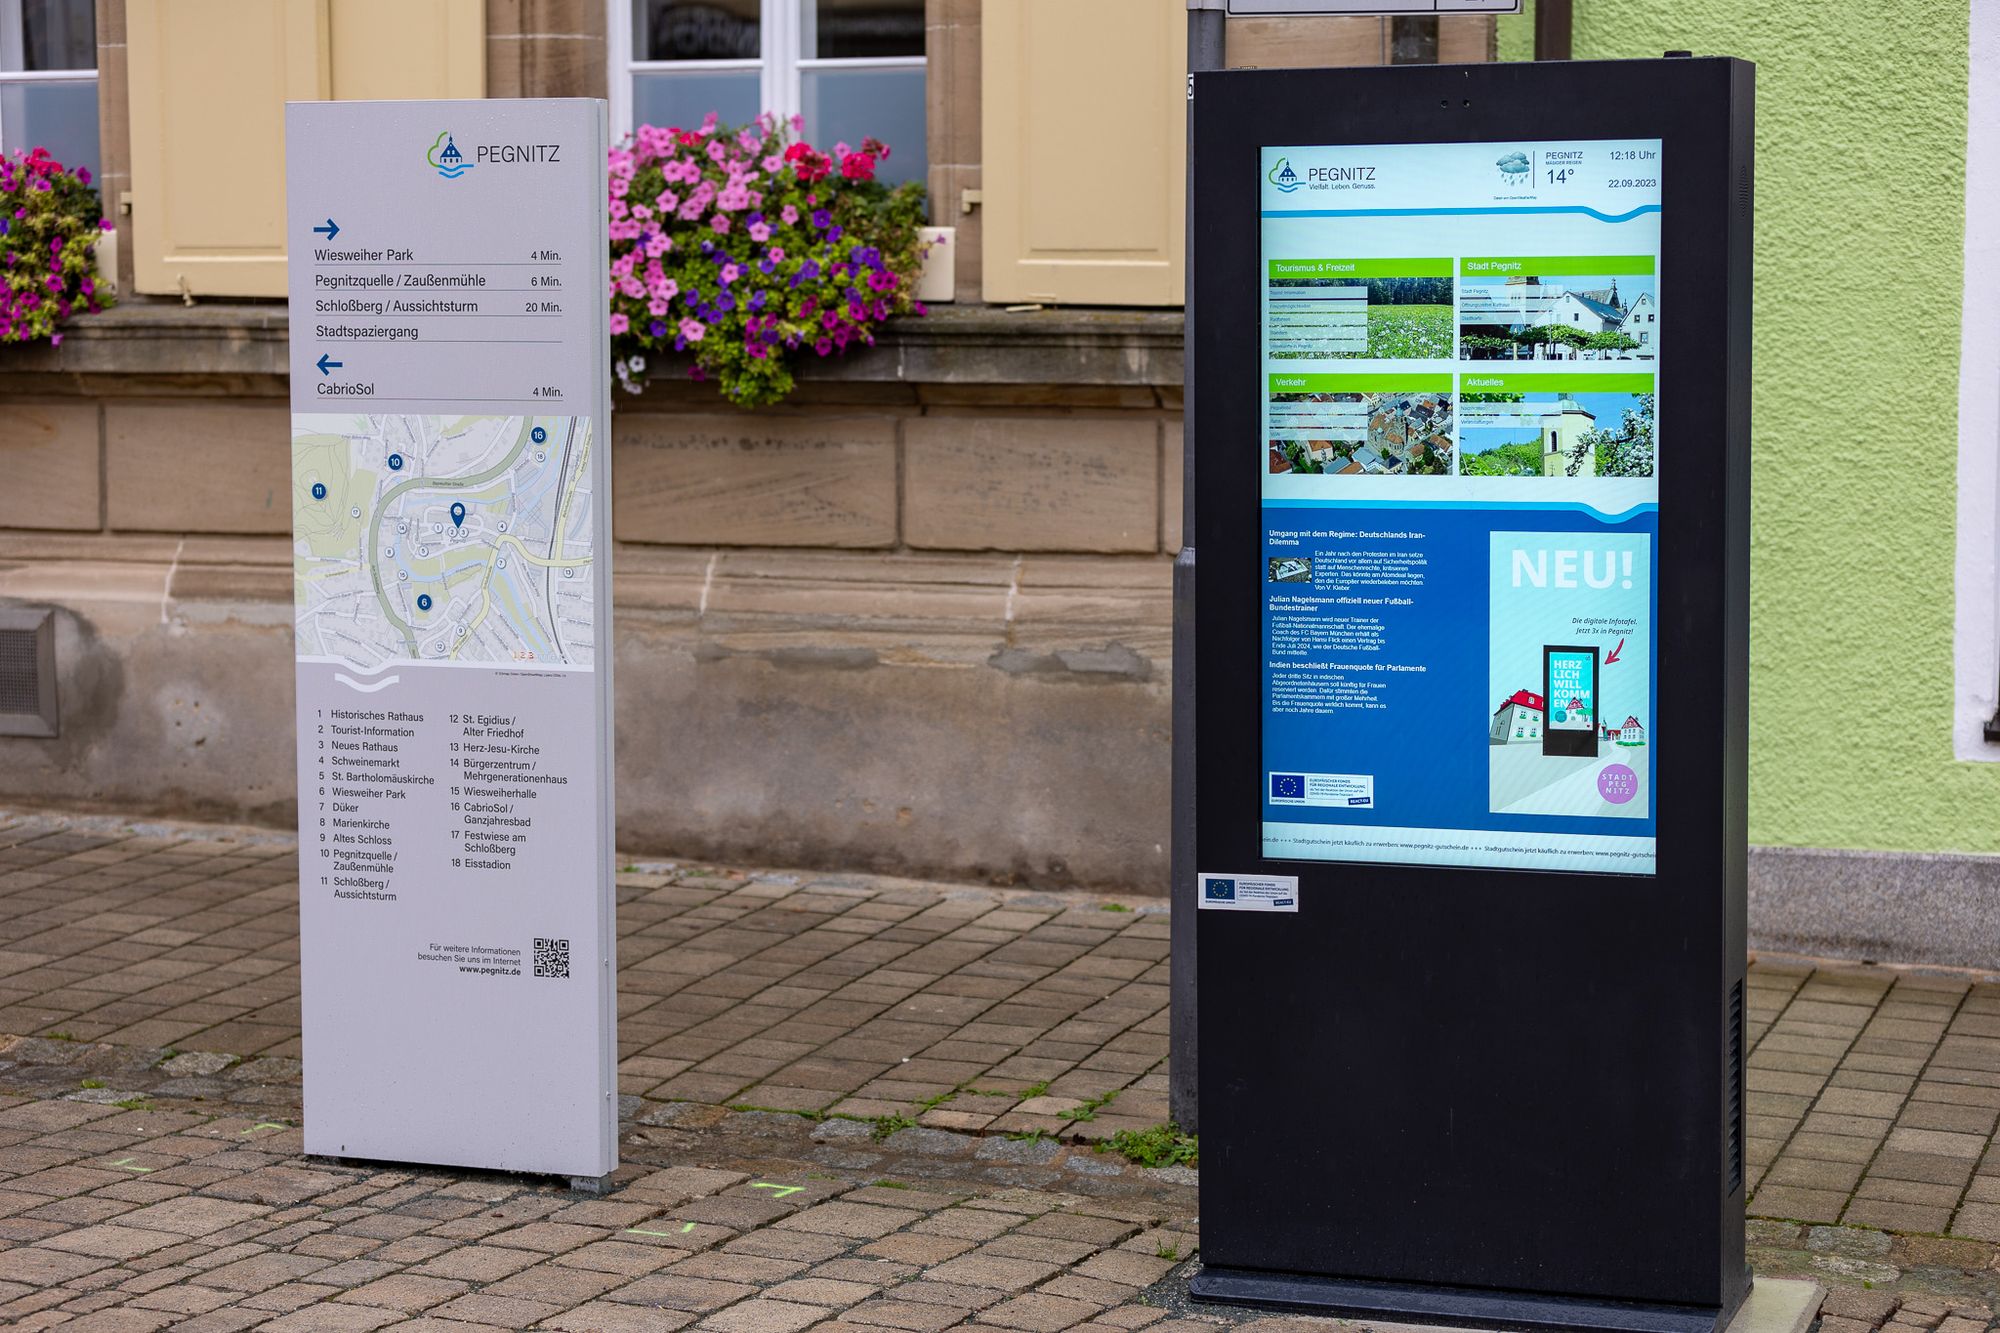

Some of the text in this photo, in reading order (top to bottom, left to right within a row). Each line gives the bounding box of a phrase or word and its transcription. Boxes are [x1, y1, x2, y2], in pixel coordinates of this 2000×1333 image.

[477, 145, 560, 163] PEGNITZ
[1610, 150, 1656, 160] 12:18 Uhr
[1308, 167, 1376, 181] PEGNITZ
[1547, 168, 1574, 184] 14°
[1608, 179, 1657, 188] 22.09.2023
[314, 248, 562, 261] Wiesweiher Park 4 Min.
[1276, 264, 1316, 272] Tourismus
[1326, 263, 1355, 271] Freizeit
[1468, 262, 1521, 271] Stadt Pegnitz
[315, 274, 394, 289] Pegnitzquelle
[404, 273, 486, 287] Zaußenmühle
[531, 277, 537, 287] 6
[540, 277, 562, 287] Min.
[315, 299, 383, 314] Schloßberg
[393, 299, 478, 313] Aussichtsturm
[525, 303, 538, 313] 20
[541, 302, 562, 313] Min.
[316, 325, 419, 340] Stadtspaziergang
[1275, 378, 1306, 386] Verkehr
[1467, 378, 1504, 386] Aktuelles
[317, 382, 563, 397] CabrioSol 4 Min.
[534, 431, 543, 439] 16
[391, 458, 400, 466] 10
[315, 487, 323, 495] 11
[1269, 530, 1298, 539] Umgang
[1329, 531, 1358, 539] Regime:
[1512, 549, 1633, 589] NEU!
[421, 597, 428, 606] 6
[1292, 596, 1334, 604] Nagelsmann
[1583, 617, 1608, 625] digitale
[436, 642, 444, 650] 12
[1330, 663, 1373, 671] Frauenquote
[1387, 664, 1426, 672] Parlamente
[1554, 660, 1582, 669] HERZ
[1554, 669, 1580, 679] LICH
[1553, 679, 1581, 689] WILL
[1554, 689, 1590, 699] KOMM
[1554, 700, 1566, 708] EN
[331, 710, 385, 721] Historisches
[388, 712, 424, 722] Rathaus
[449, 715, 459, 723] 12
[463, 715, 475, 724] St.
[477, 715, 510, 726] Egidius
[318, 725, 415, 737] 2 Tourist-Information
[463, 728, 524, 738] Alter Friedhof
[318, 741, 398, 752] 3 Neues Rathaus
[450, 743, 540, 754] 13 Herz-Jesu-Kirche
[331, 757, 400, 768] Schweinemarkt
[450, 759, 459, 767] 14
[463, 758, 530, 770] Bürgerzentrum
[319, 772, 435, 785] 5 St. Bartholomäuskirche
[464, 772, 568, 784] Mehrgenerationenhaus
[1602, 773, 1633, 781] STADT
[1608, 780, 1627, 788] PEG
[319, 787, 406, 799] 6 Wiesweiher Park
[451, 787, 536, 798] 15 Wiesweiherhalle
[319, 803, 359, 812] 7 Düker
[451, 803, 460, 811] 16
[464, 803, 508, 813] CabrioSol
[333, 818, 390, 830] Marienkirche
[464, 815, 531, 828] Ganzjahresbad
[320, 834, 392, 845] 9 Altes Schloss
[451, 831, 526, 842] 17 Festwiese am
[464, 842, 516, 856] Schloßberg
[333, 849, 392, 861] Pegnitzquelle
[333, 862, 394, 873] Zaußenmühle
[452, 859, 511, 870] 18 Eisstadion
[321, 877, 328, 885] 11
[334, 877, 384, 890] Schloßberg
[334, 889, 397, 901] Aussichtsturm
[443, 944, 469, 952] weitere
[471, 946, 521, 956] Informationen
[418, 952, 452, 962] besuchen
[454, 954, 465, 962] Sie
[482, 955, 491, 964] im
[493, 957, 521, 966] Internet
[459, 965, 521, 976] www.pegnitz.de
